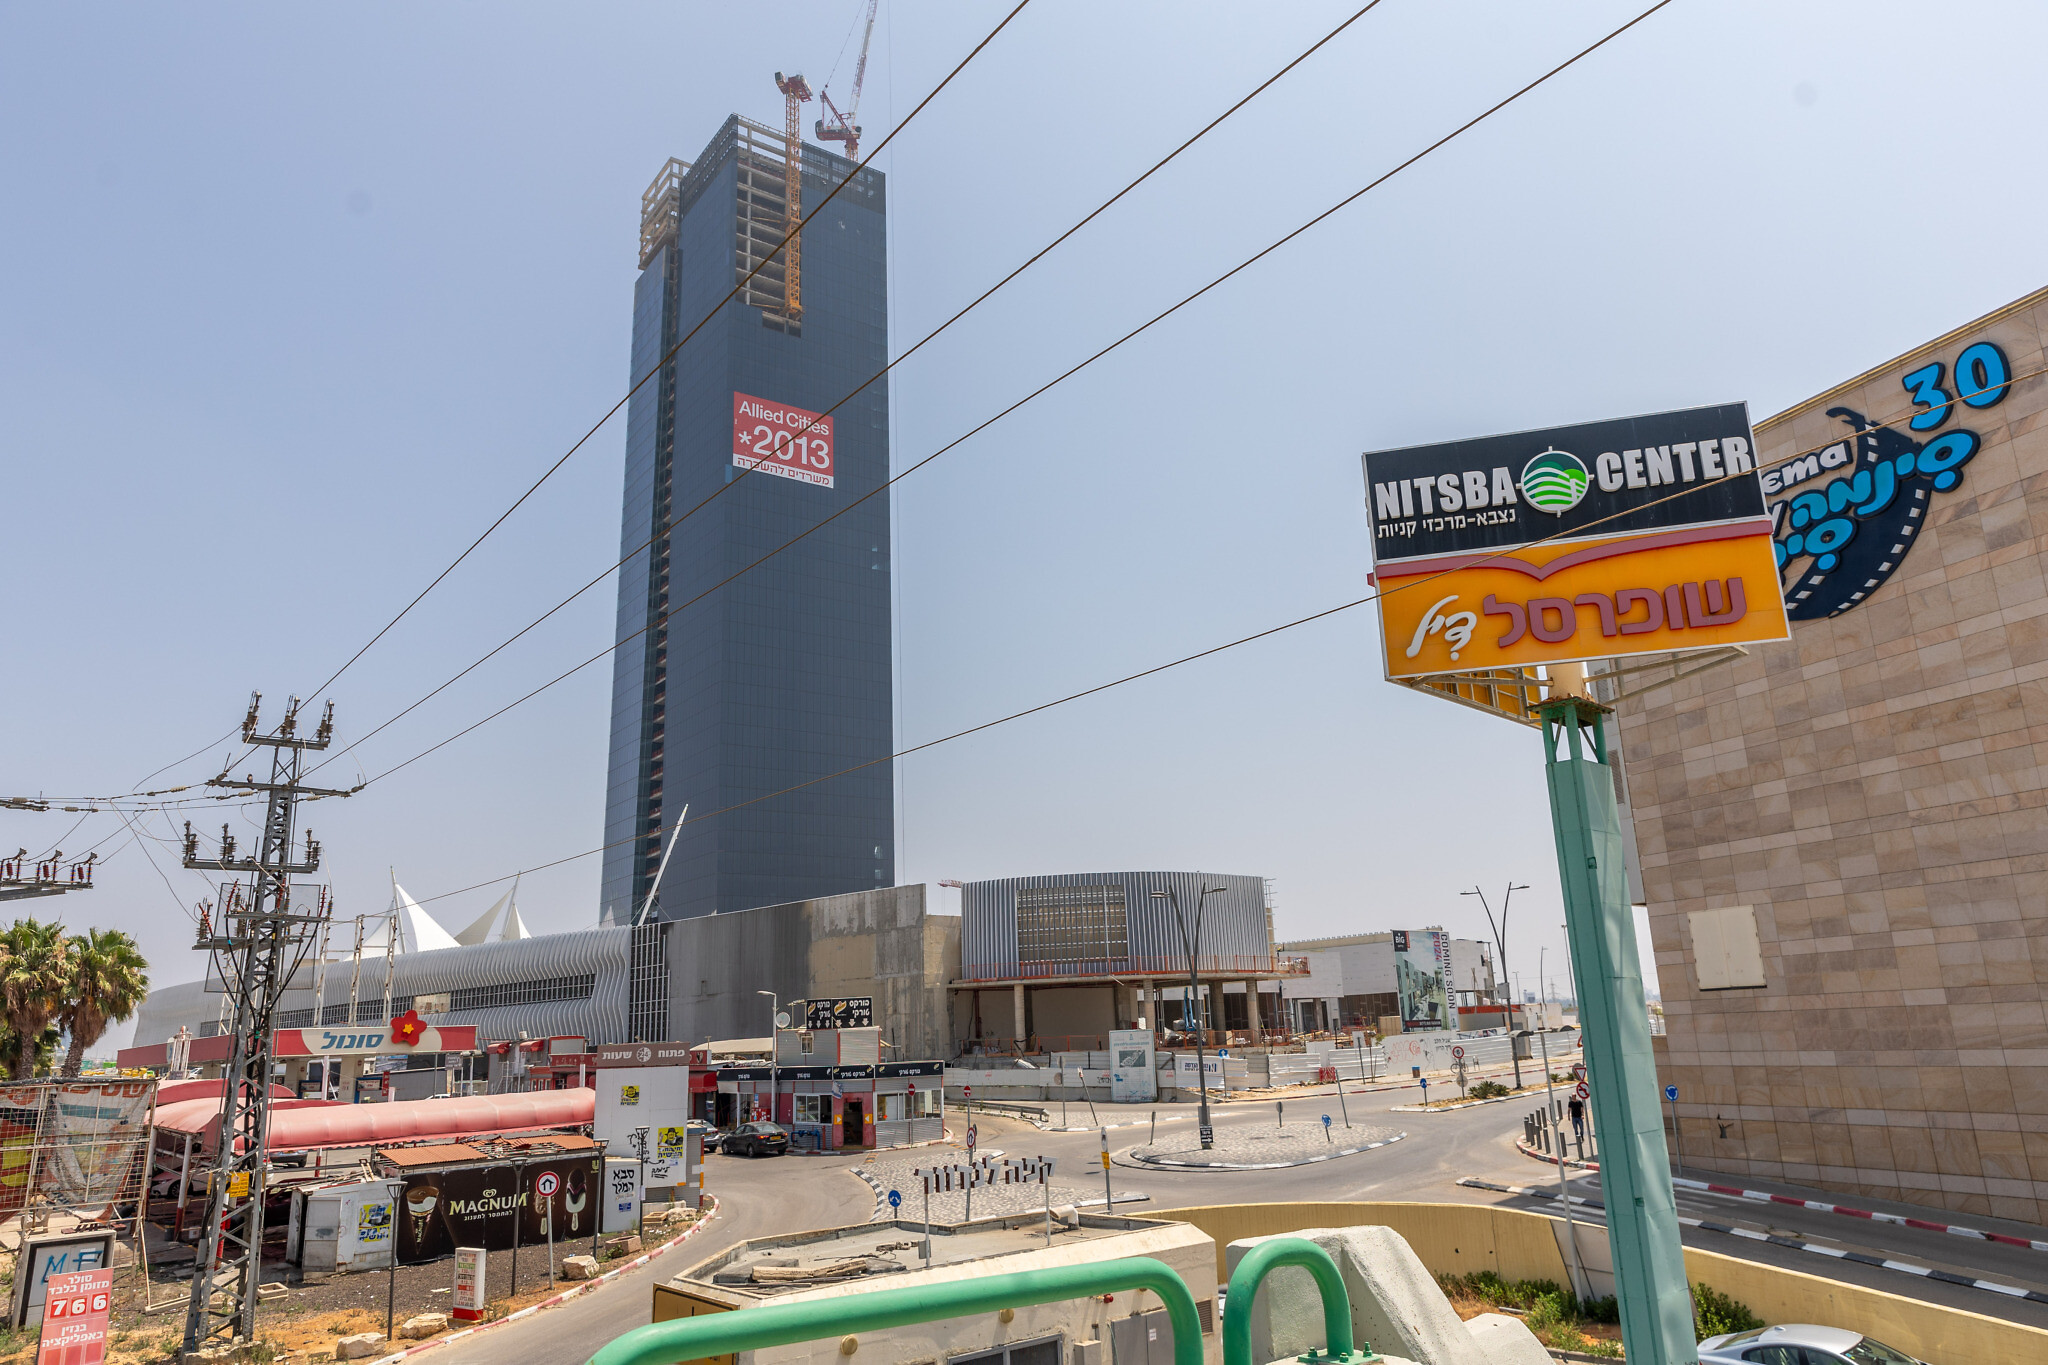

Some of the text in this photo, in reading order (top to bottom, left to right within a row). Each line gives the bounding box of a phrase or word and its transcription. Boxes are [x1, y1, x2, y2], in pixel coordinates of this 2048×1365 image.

[1902, 341, 2012, 432] 30
[739, 401, 830, 436] Allied Cities
[737, 457, 830, 486] משרדים להשכרה
[1374, 436, 1753, 522] NITSBA CENTER
[1377, 519, 1418, 539] קניות
[1482, 576, 1749, 649] שופרסל
[1432, 933, 1443, 961] 2024
[1440, 934, 1457, 1010] COMING SOON
[849, 999, 870, 1009] בורקס
[852, 1008, 870, 1019] טורקי
[320, 1031, 385, 1050] סונול
[602, 1050, 633, 1060] שעות
[657, 1049, 686, 1058] פתוח
[612, 1168, 635, 1181] סבא
[914, 1154, 1058, 1195] קפה לנדוור
[612, 1181, 635, 1195] המלך
[449, 1192, 528, 1216] MAGNUM
[48, 1280, 110, 1296] מזומן בלבד
[67, 1274, 94, 1285] סולר
[41, 1331, 104, 1348] באפליקציה
[61, 1324, 88, 1337] בנזין
